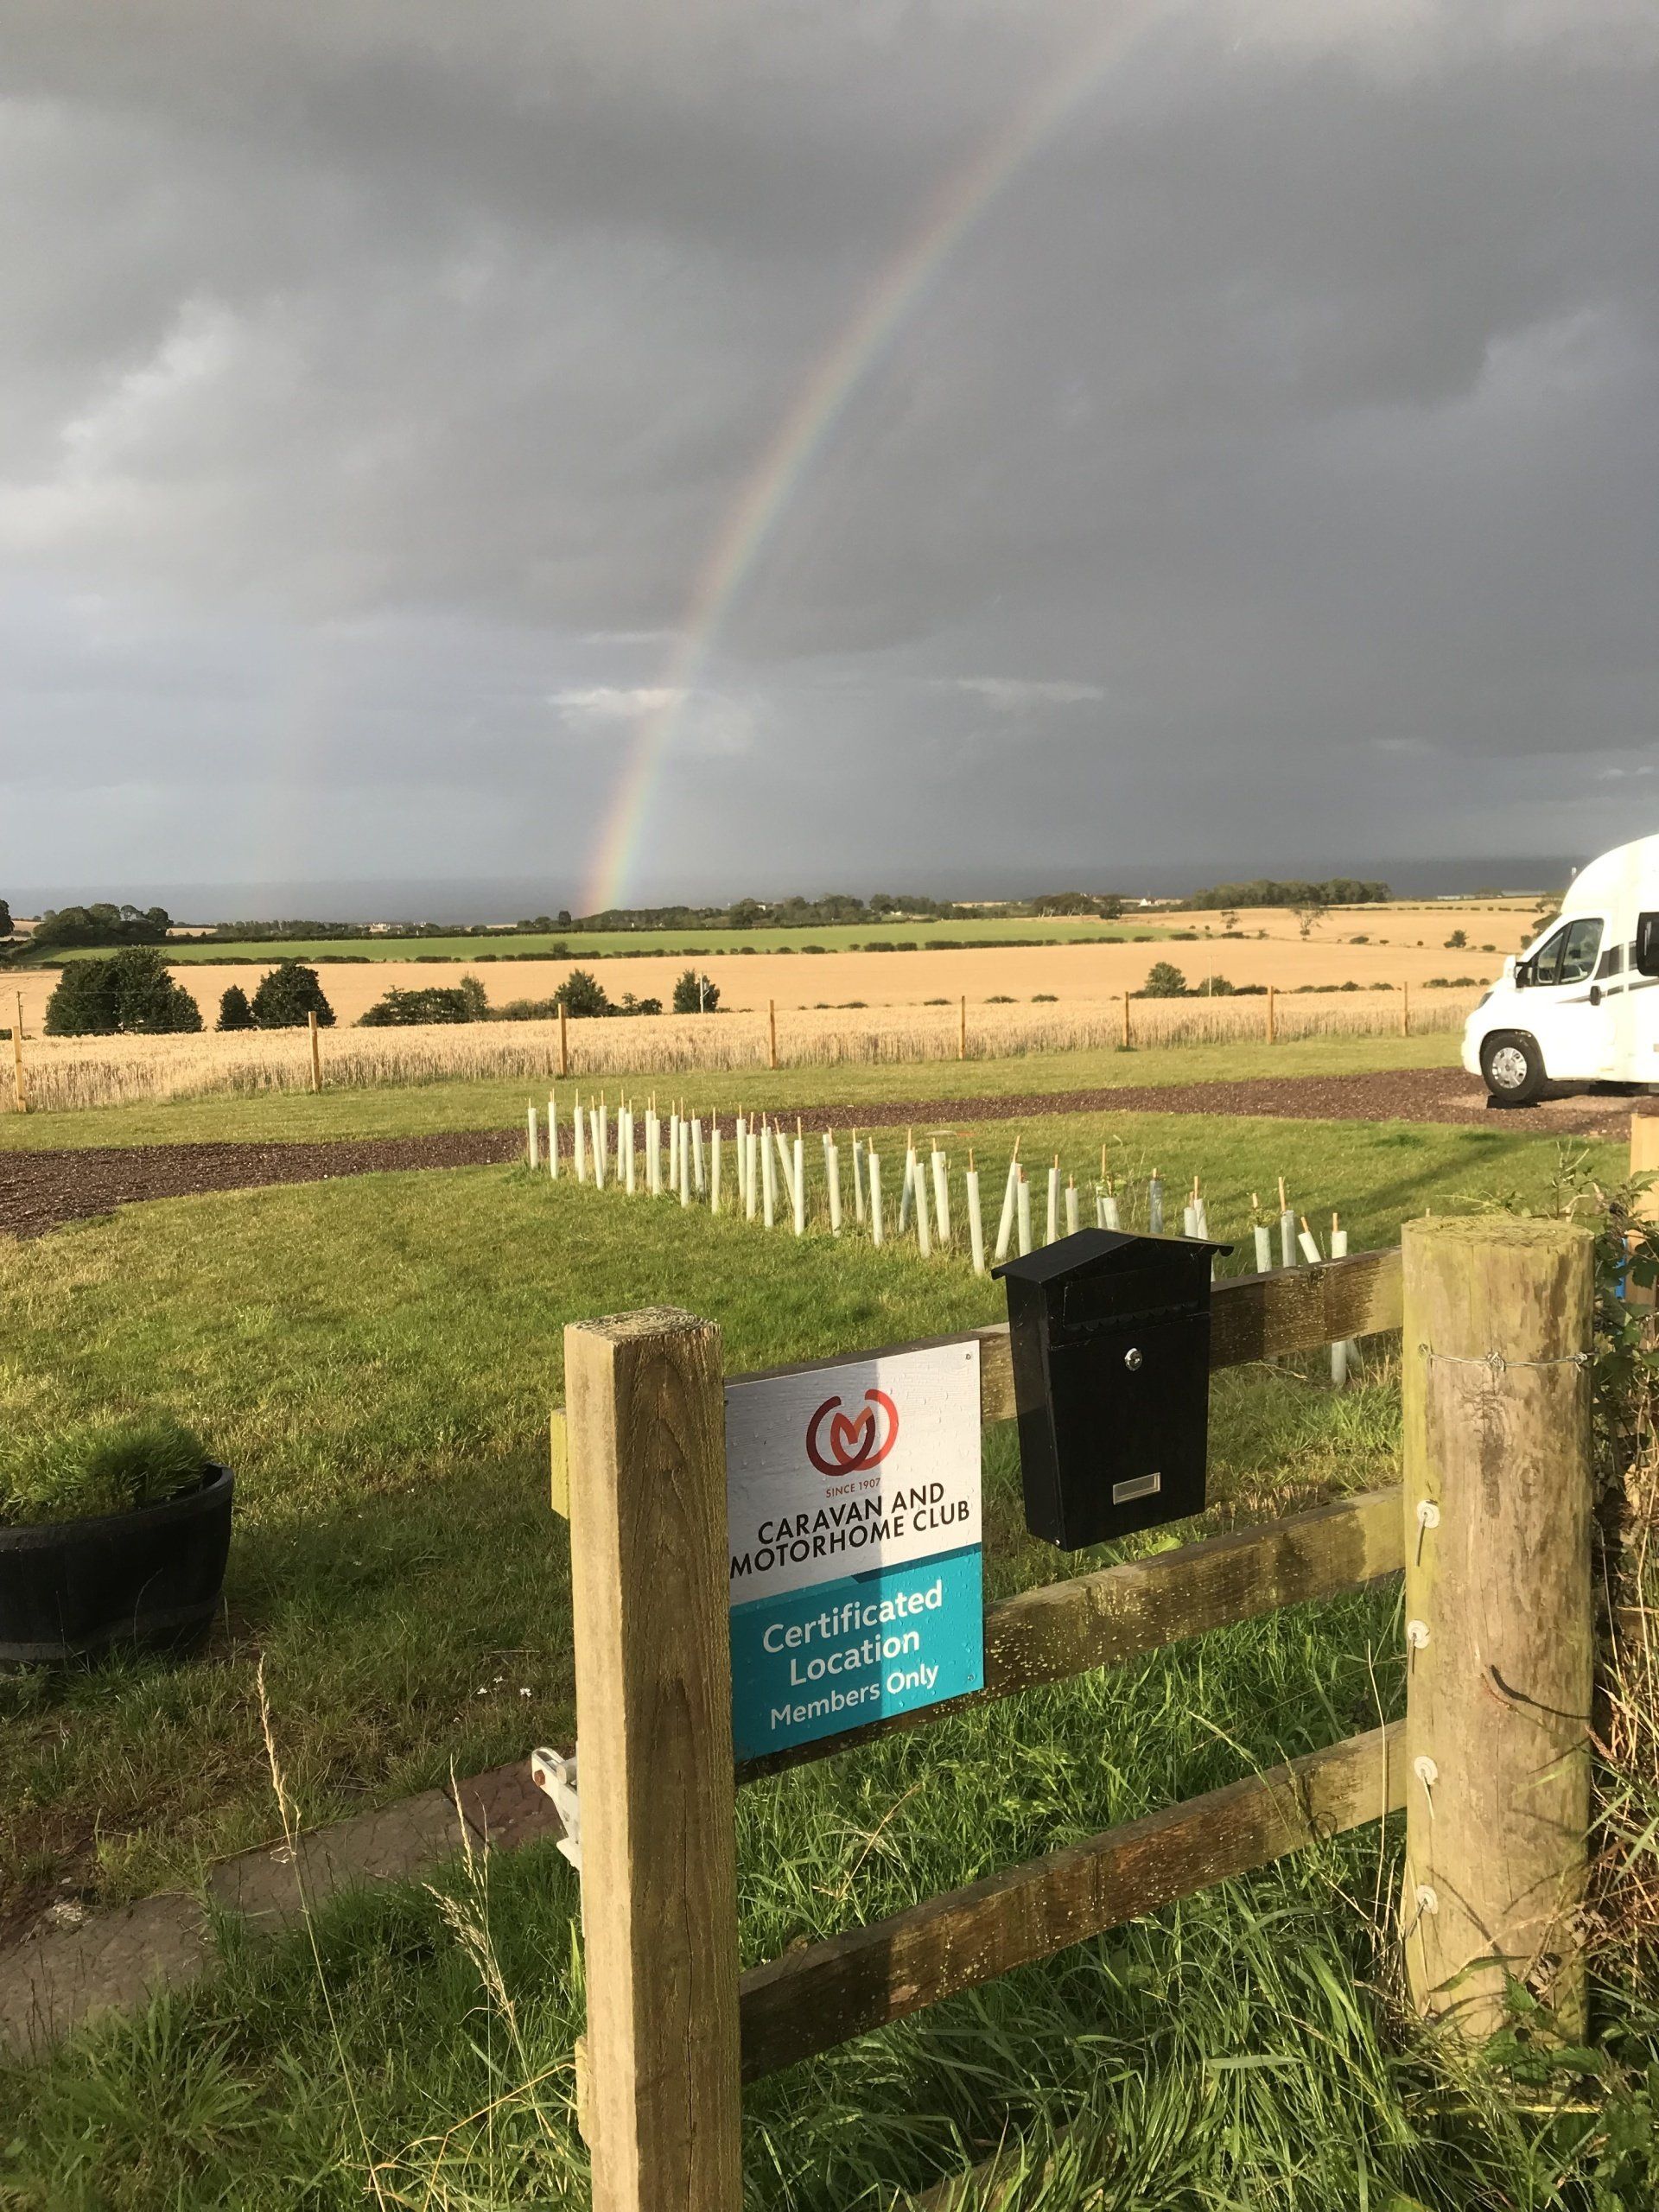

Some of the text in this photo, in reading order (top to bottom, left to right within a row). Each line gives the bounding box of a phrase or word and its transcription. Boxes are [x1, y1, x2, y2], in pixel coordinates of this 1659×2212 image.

[757, 1482, 944, 1545] CARAVAN AND
[825, 1478, 881, 1498] SINCE 1907
[729, 1500, 969, 1580] MOTORHOME CLUB
[763, 1580, 943, 1653] Certificated
[790, 1630, 920, 1687] Location
[771, 1662, 939, 1730] Members Only
